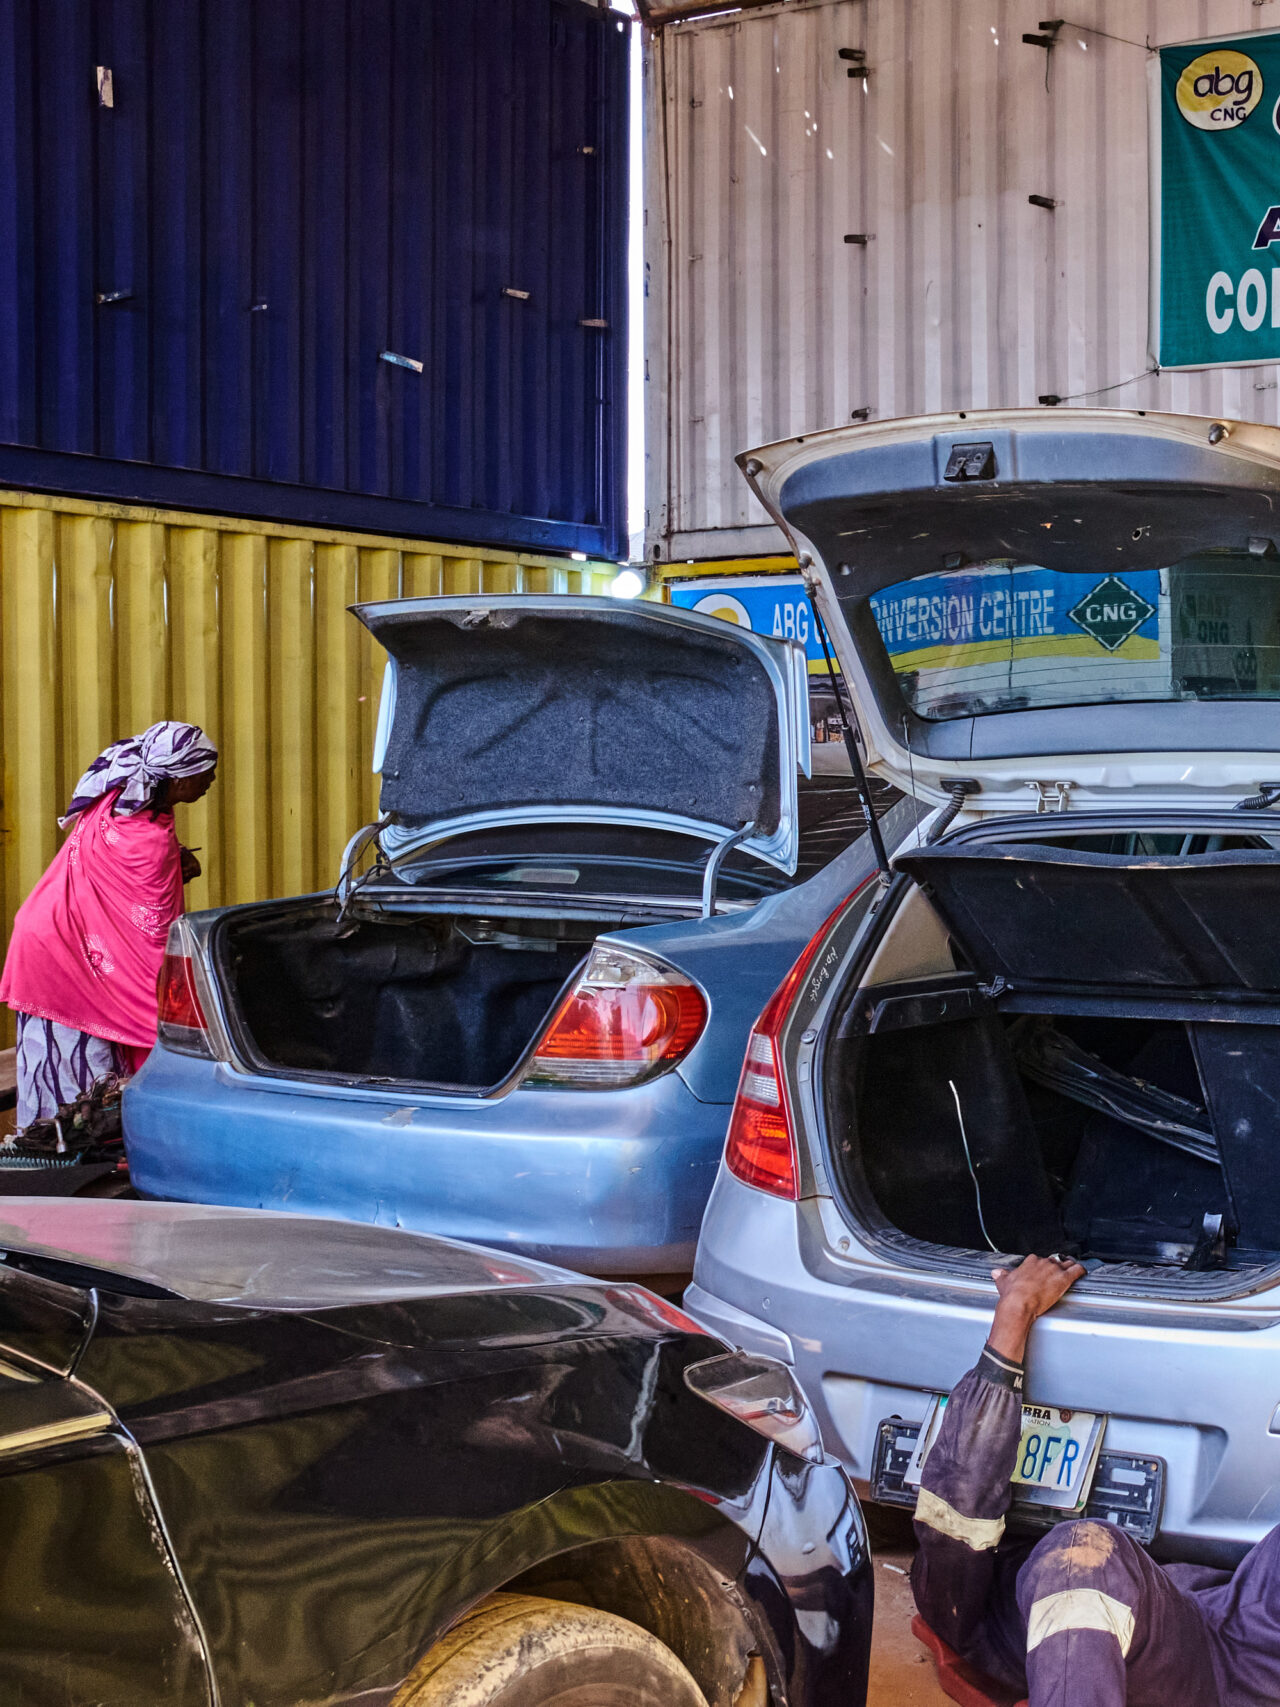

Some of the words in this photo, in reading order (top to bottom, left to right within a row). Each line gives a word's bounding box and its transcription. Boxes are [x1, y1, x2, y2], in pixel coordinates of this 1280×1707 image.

[1193, 66, 1253, 108] abg
[1210, 107, 1247, 122] CNG
[773, 602, 809, 644] ABG
[979, 589, 1055, 638] CENTRE
[1085, 602, 1137, 623] CNG
